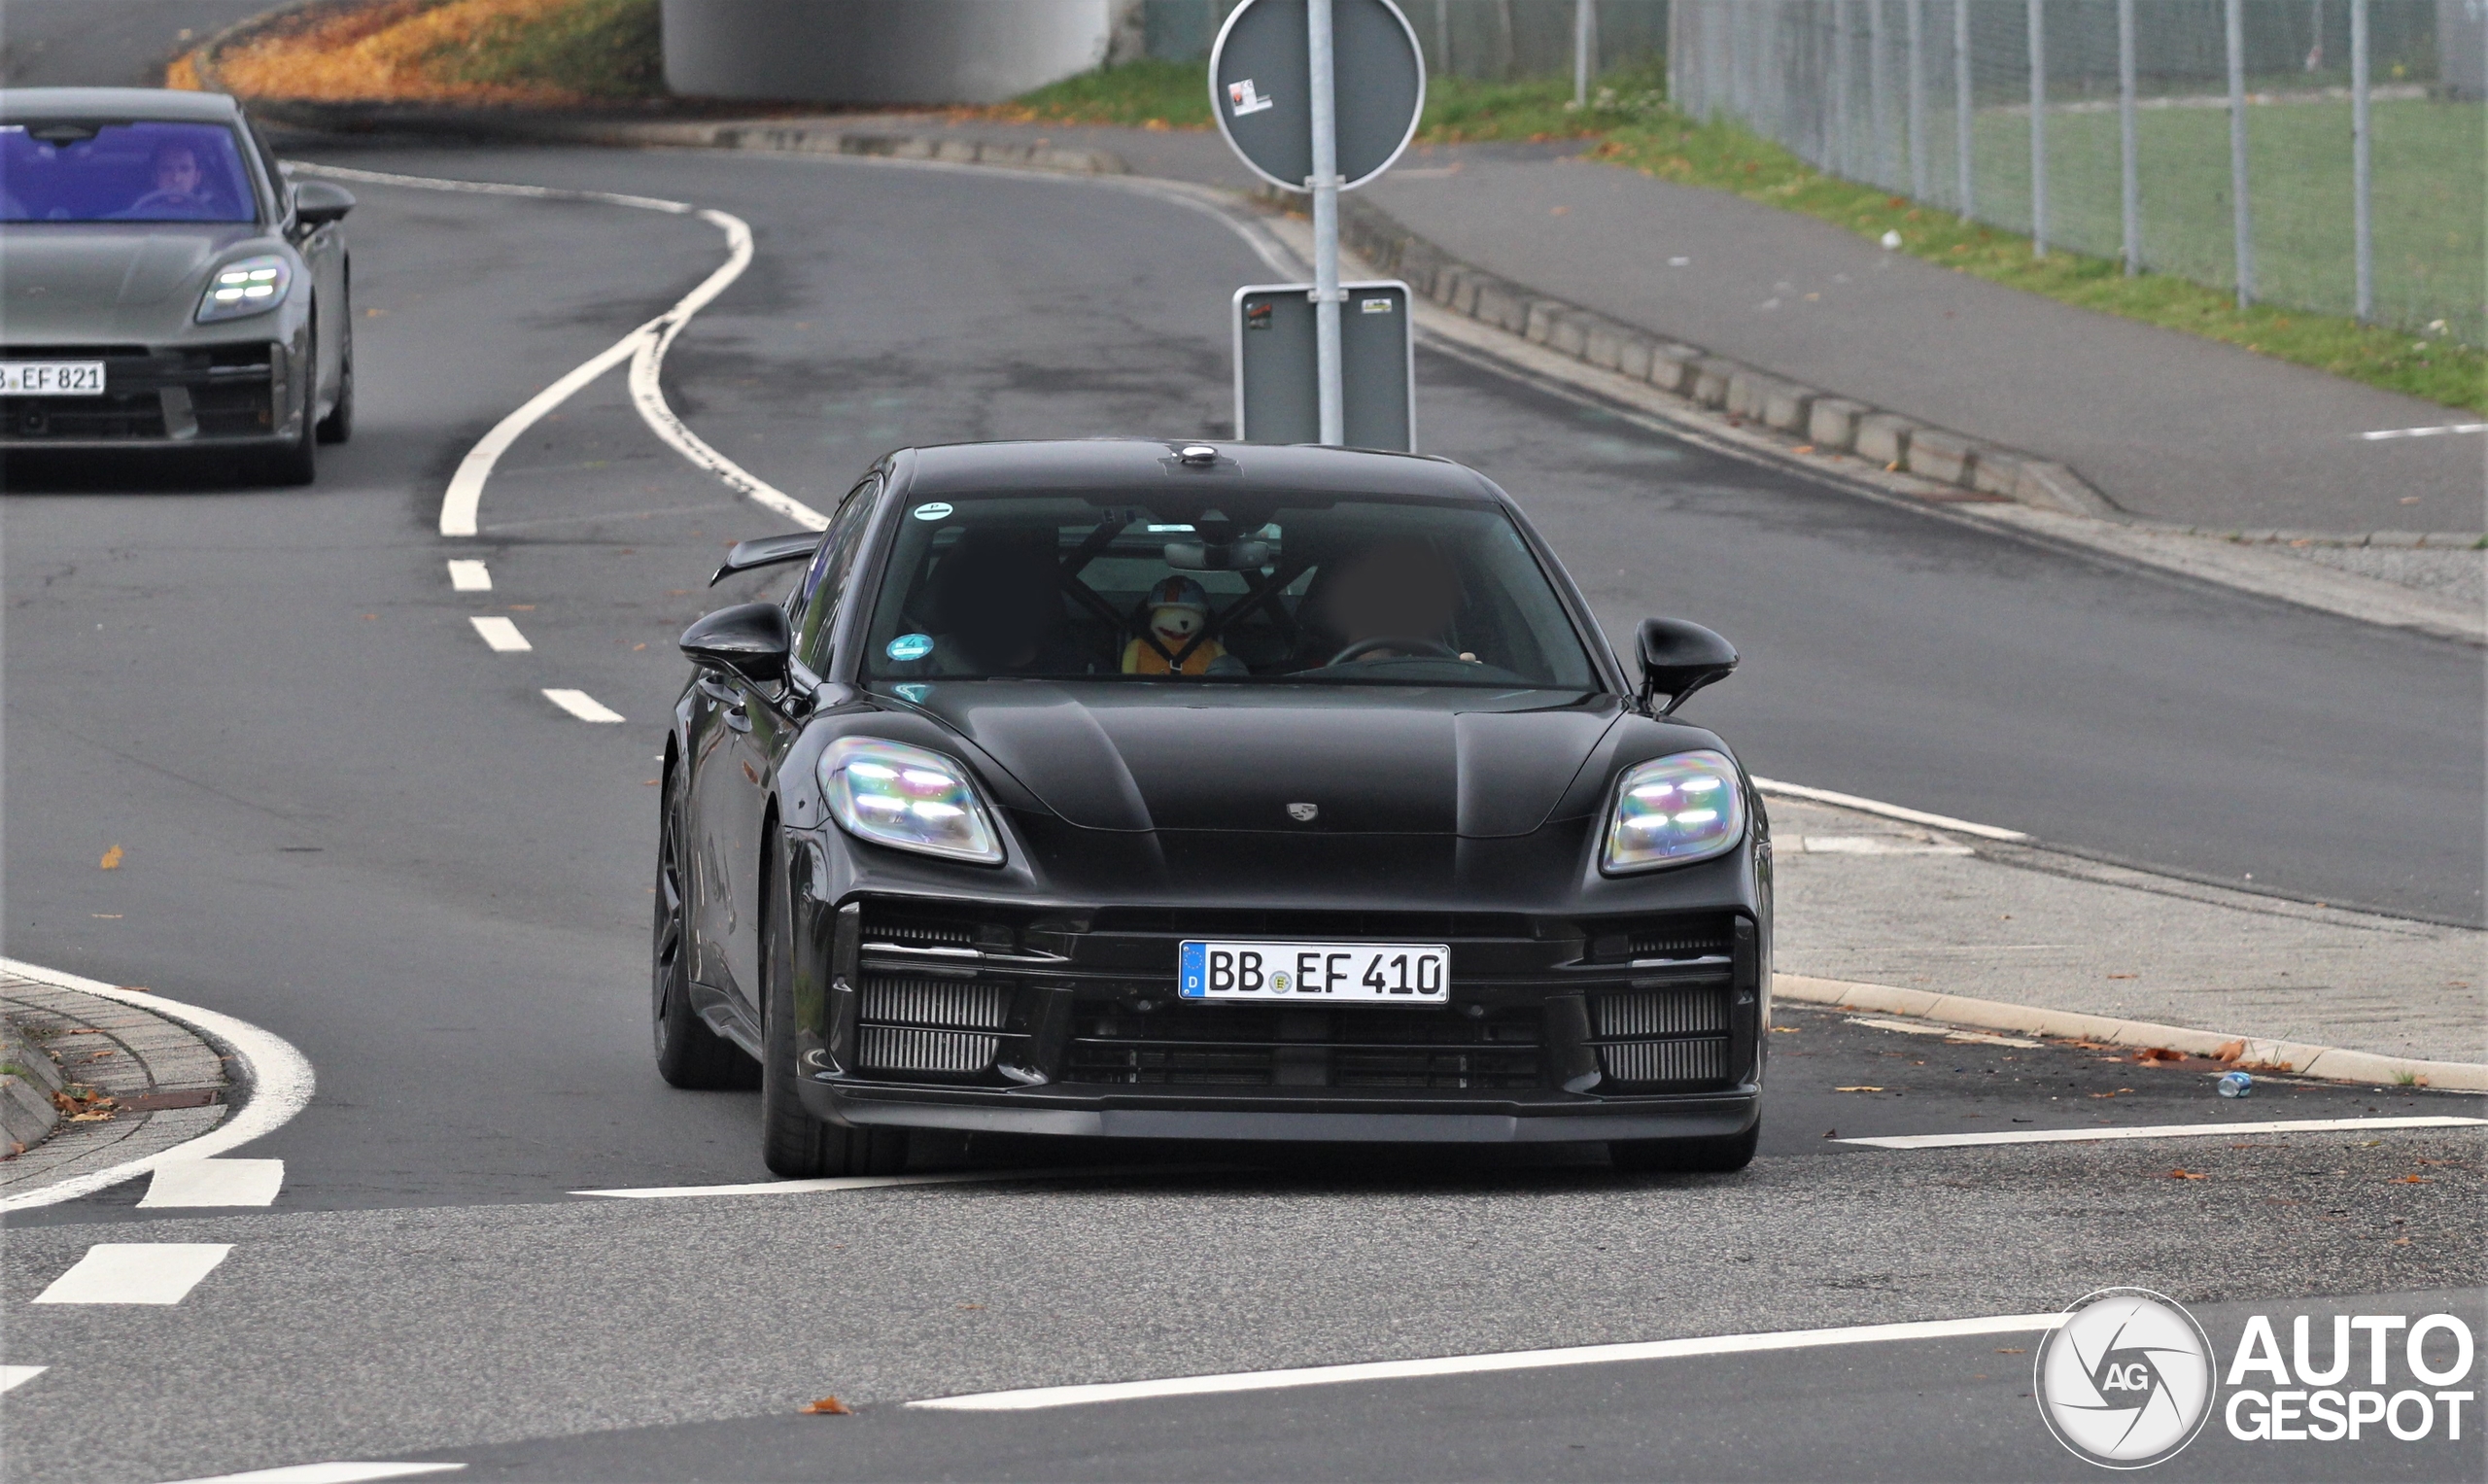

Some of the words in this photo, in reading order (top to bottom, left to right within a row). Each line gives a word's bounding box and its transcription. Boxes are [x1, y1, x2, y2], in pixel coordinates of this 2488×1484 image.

[22, 367, 52, 389] EF
[58, 367, 101, 389] 821
[905, 638, 916, 647] 4
[1210, 950, 1264, 991] BB
[1296, 952, 1352, 993] EF
[1362, 953, 1442, 995] 410
[1189, 976, 1198, 988] D
